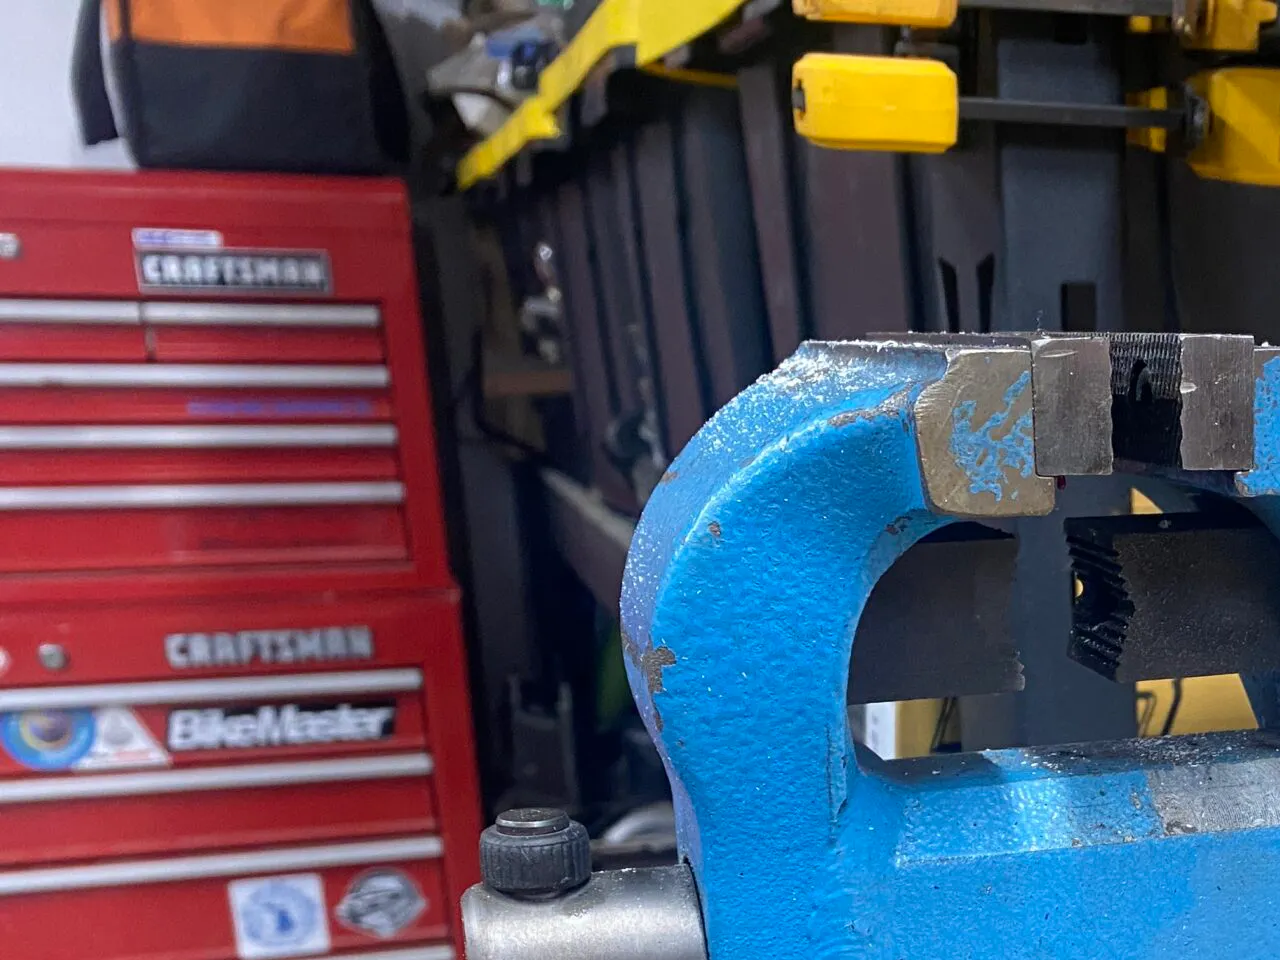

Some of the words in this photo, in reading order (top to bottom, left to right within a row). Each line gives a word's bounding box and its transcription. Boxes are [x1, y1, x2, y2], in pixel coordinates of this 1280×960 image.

[142, 254, 322, 284] CRAFTSMAN
[164, 625, 373, 668] CRAFTSMAN
[168, 703, 395, 749] BikeMaster
